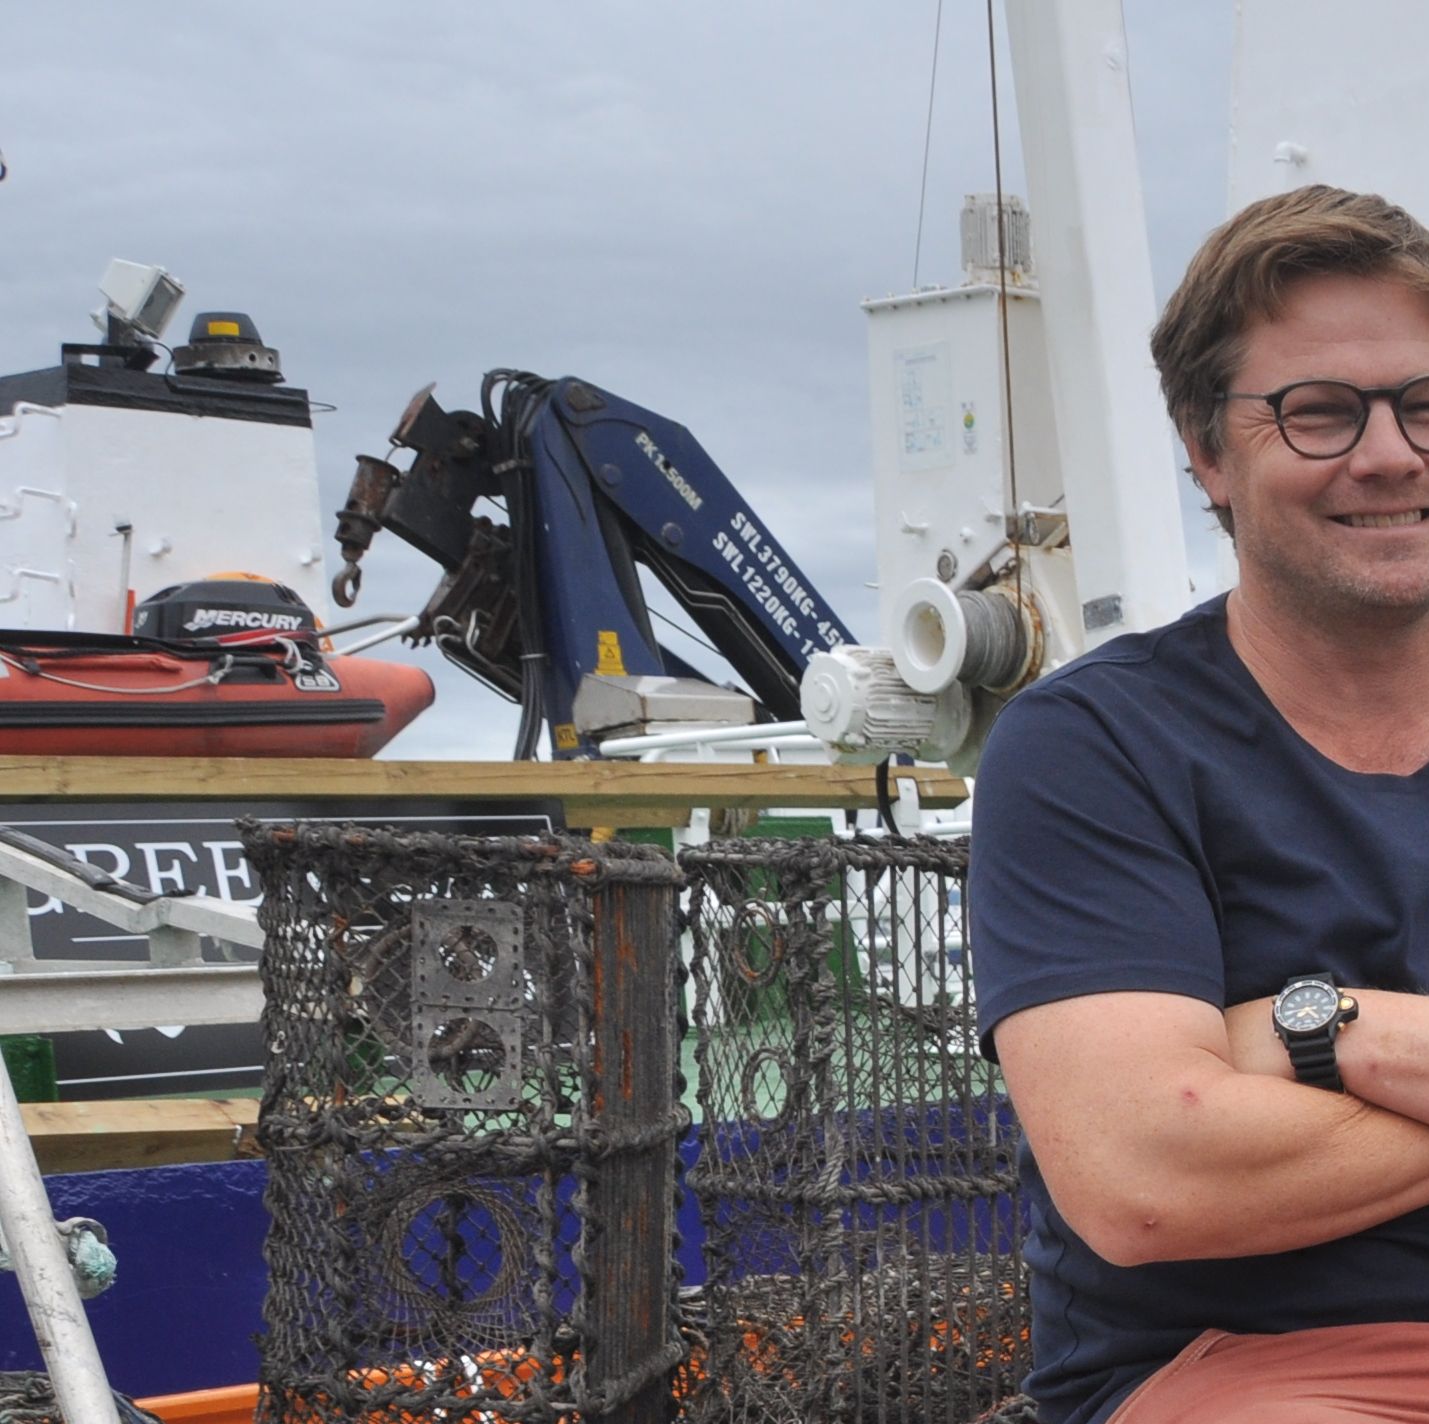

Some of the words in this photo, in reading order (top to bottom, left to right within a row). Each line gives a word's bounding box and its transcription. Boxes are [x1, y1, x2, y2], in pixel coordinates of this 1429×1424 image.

[712, 531, 746, 573] SWL
[730, 511, 762, 553] SWL
[194, 608, 302, 630] MERCURY
